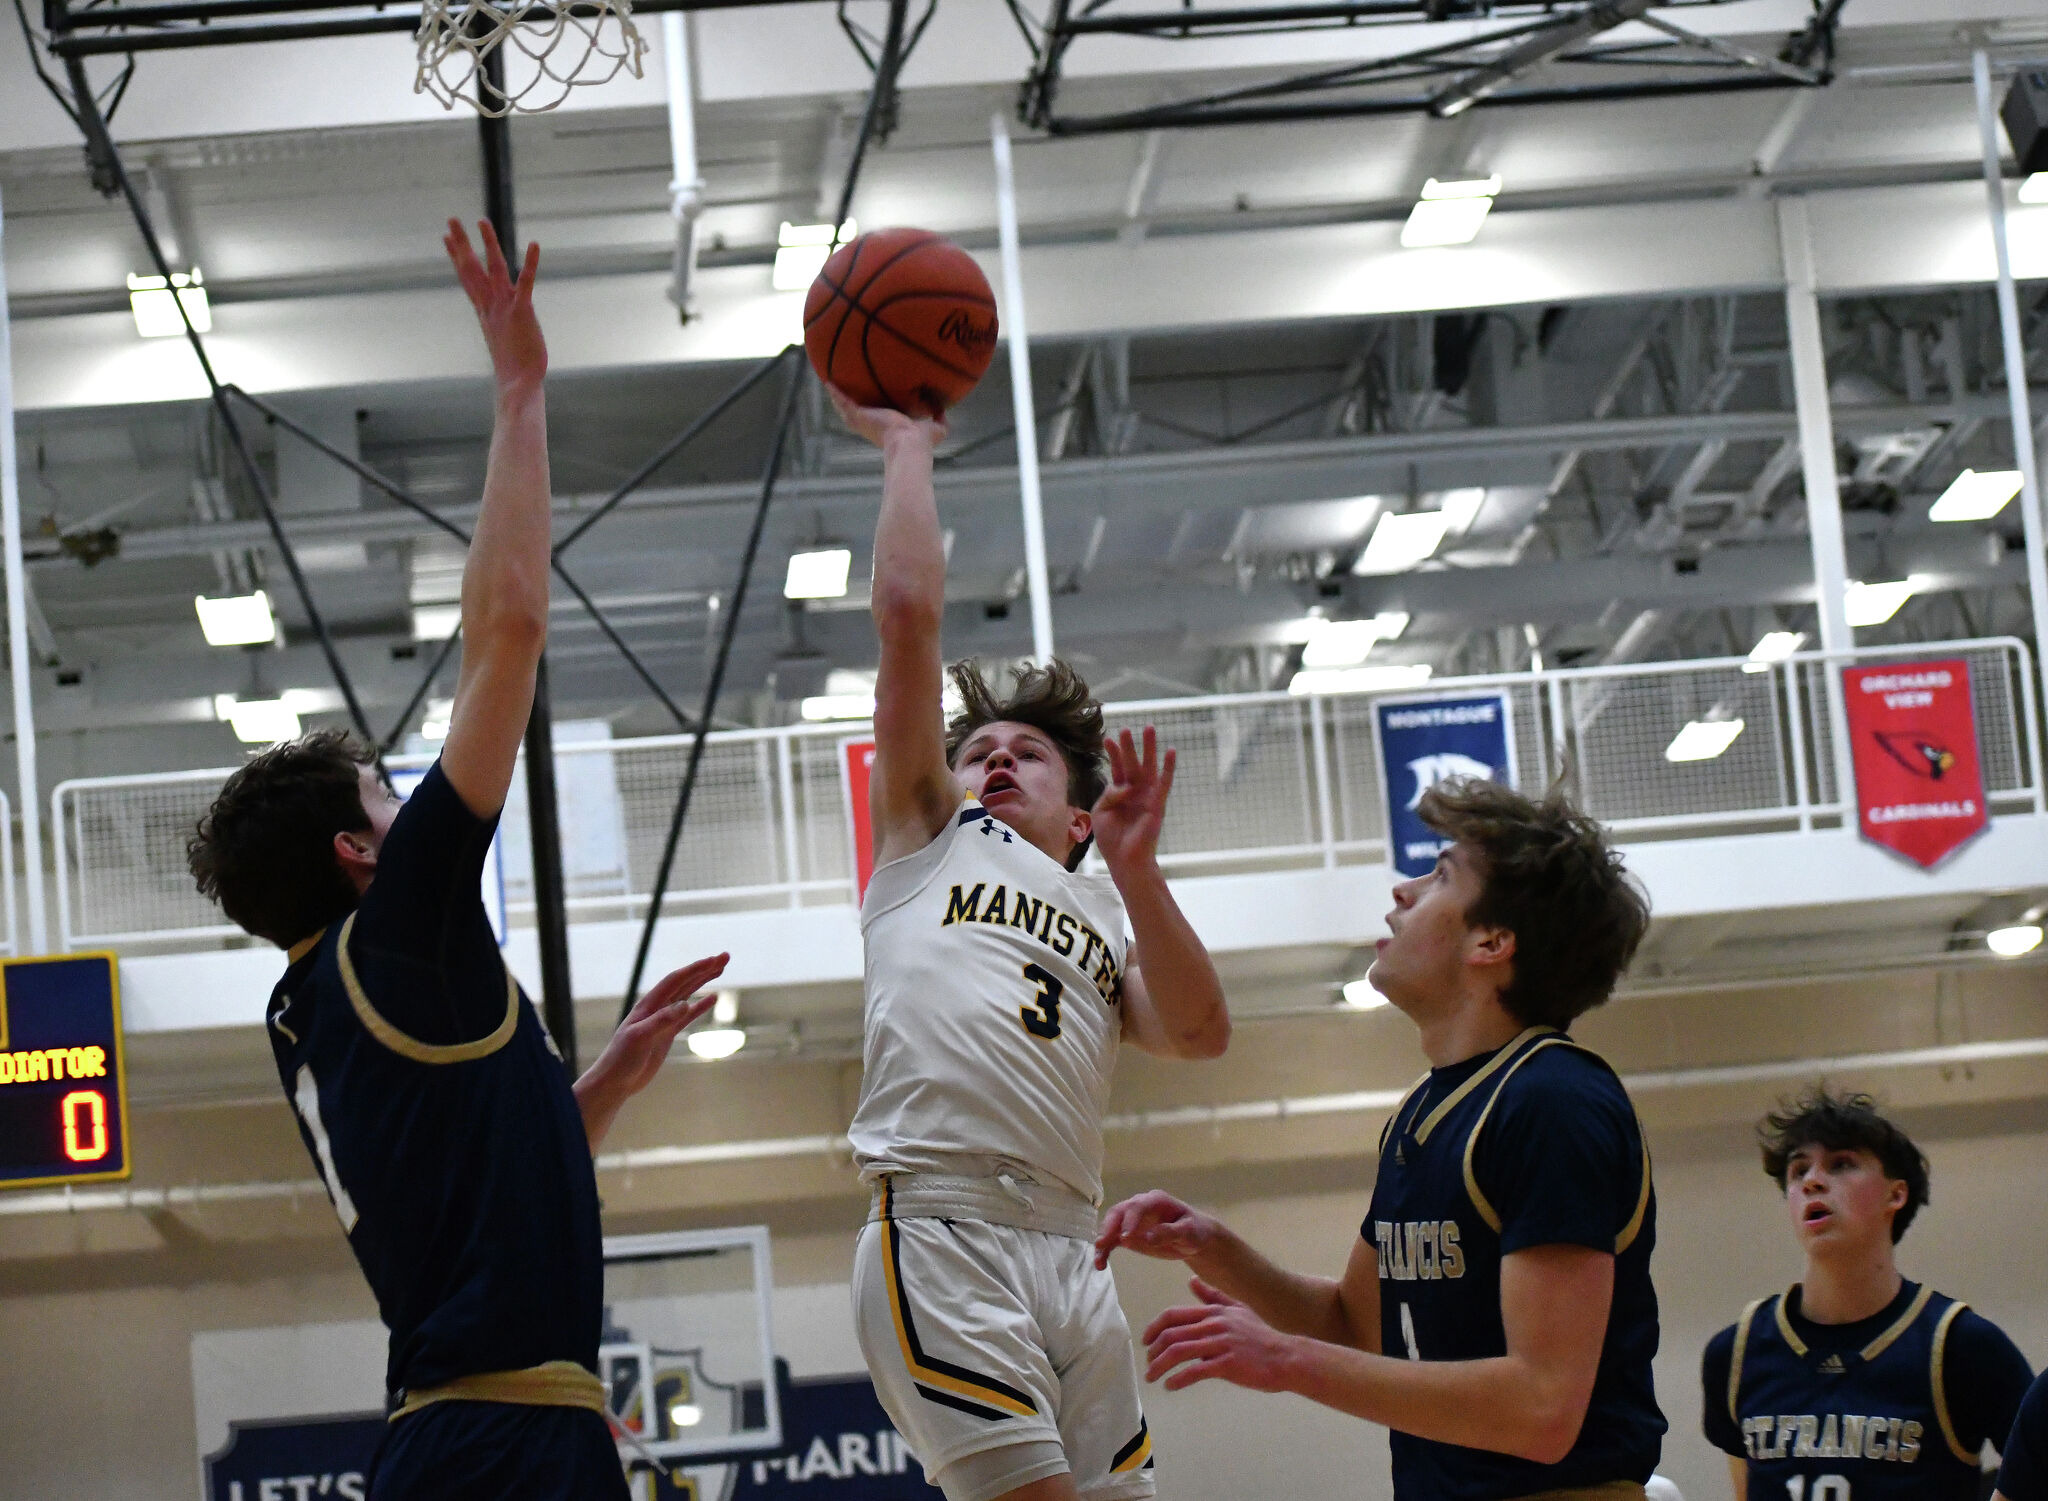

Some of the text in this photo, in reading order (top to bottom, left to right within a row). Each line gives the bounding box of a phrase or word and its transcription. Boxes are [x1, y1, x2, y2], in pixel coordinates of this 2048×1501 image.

[1860, 670, 1953, 693] ORCHARD
[1883, 690, 1934, 709] VIEW
[1385, 704, 1496, 730] MONTAGUE
[1868, 799, 1976, 824] CARDINALS
[1019, 961, 1064, 1031] 3
[62, 1089, 108, 1161] 0
